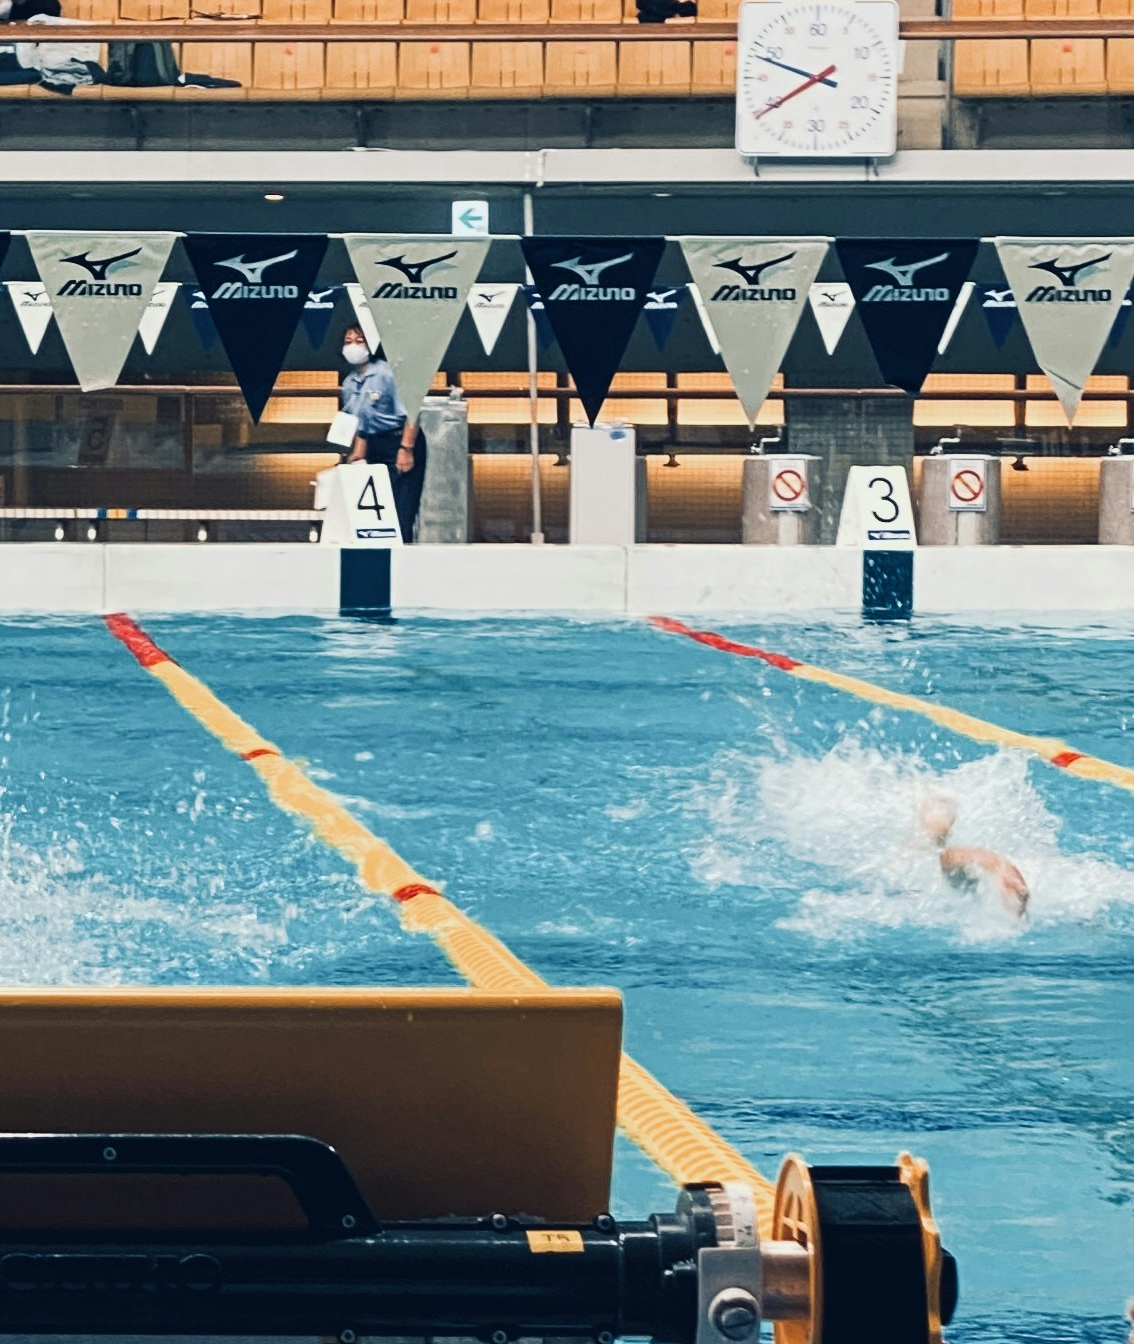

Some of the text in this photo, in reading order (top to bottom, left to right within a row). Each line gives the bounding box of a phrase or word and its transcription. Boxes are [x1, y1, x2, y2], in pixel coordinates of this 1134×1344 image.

[809, 22, 827, 36] 60
[56, 279, 143, 297] MIZUNO
[211, 281, 299, 299] MIZUNO
[371, 282, 458, 300] MIZUNO
[548, 283, 636, 301] MIZUNO
[711, 284, 796, 302] MIZUNO
[862, 285, 950, 302] MIZUNO
[1024, 285, 1113, 303] MIZUNO
[357, 474, 386, 521] 4
[868, 476, 900, 523] 3
